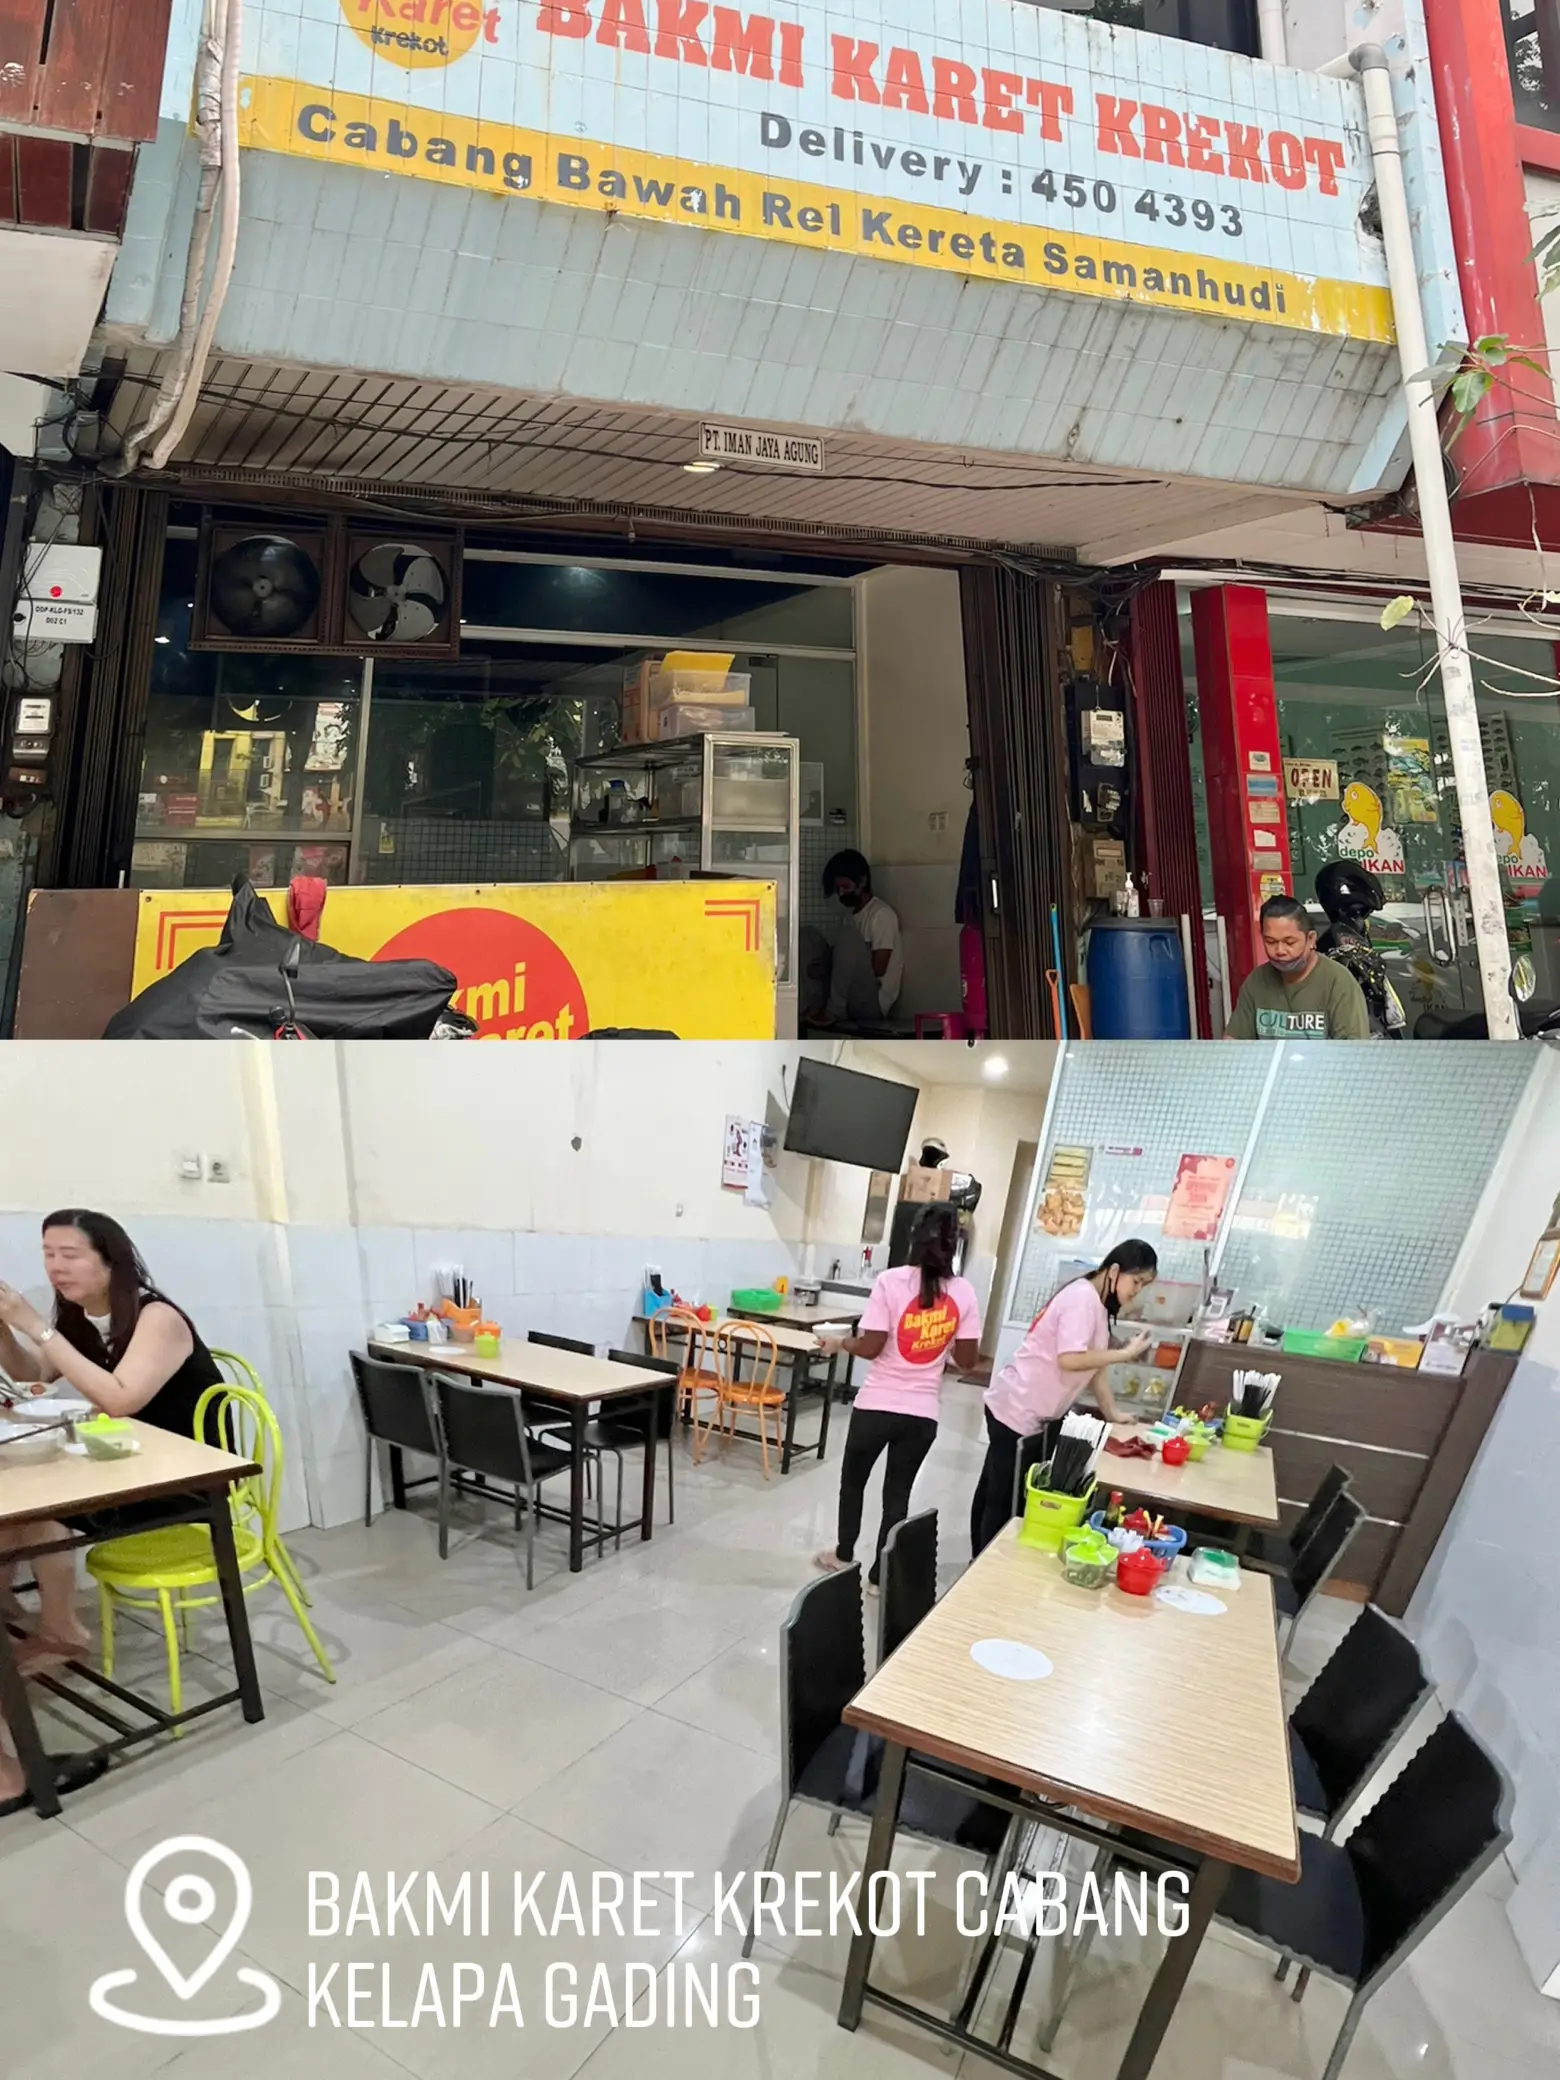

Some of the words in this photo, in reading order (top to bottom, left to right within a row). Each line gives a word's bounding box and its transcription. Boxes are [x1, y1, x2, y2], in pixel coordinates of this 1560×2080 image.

[537, 0, 804, 88] BAKMI
[831, 33, 1074, 142] KARET
[1095, 93, 1345, 196] KREKOT
[760, 111, 983, 195] Delivery
[1031, 169, 1117, 213] 450
[1134, 189, 1244, 237] 4393
[298, 103, 532, 189] Cabang
[557, 152, 742, 221] Bawah
[762, 191, 842, 235] Rel
[862, 208, 1026, 270] Kereta
[1043, 242, 1287, 313] Samanhudi
[705, 429, 721, 451] PT.
[724, 431, 752, 455] IMAN
[756, 436, 780, 459] JAYA
[784, 440, 819, 465] AGUNG
[1290, 767, 1333, 789] OPEN
[1340, 846, 1375, 860] depo
[1363, 859, 1405, 872] IKAN
[1508, 863, 1548, 879] IKAN
